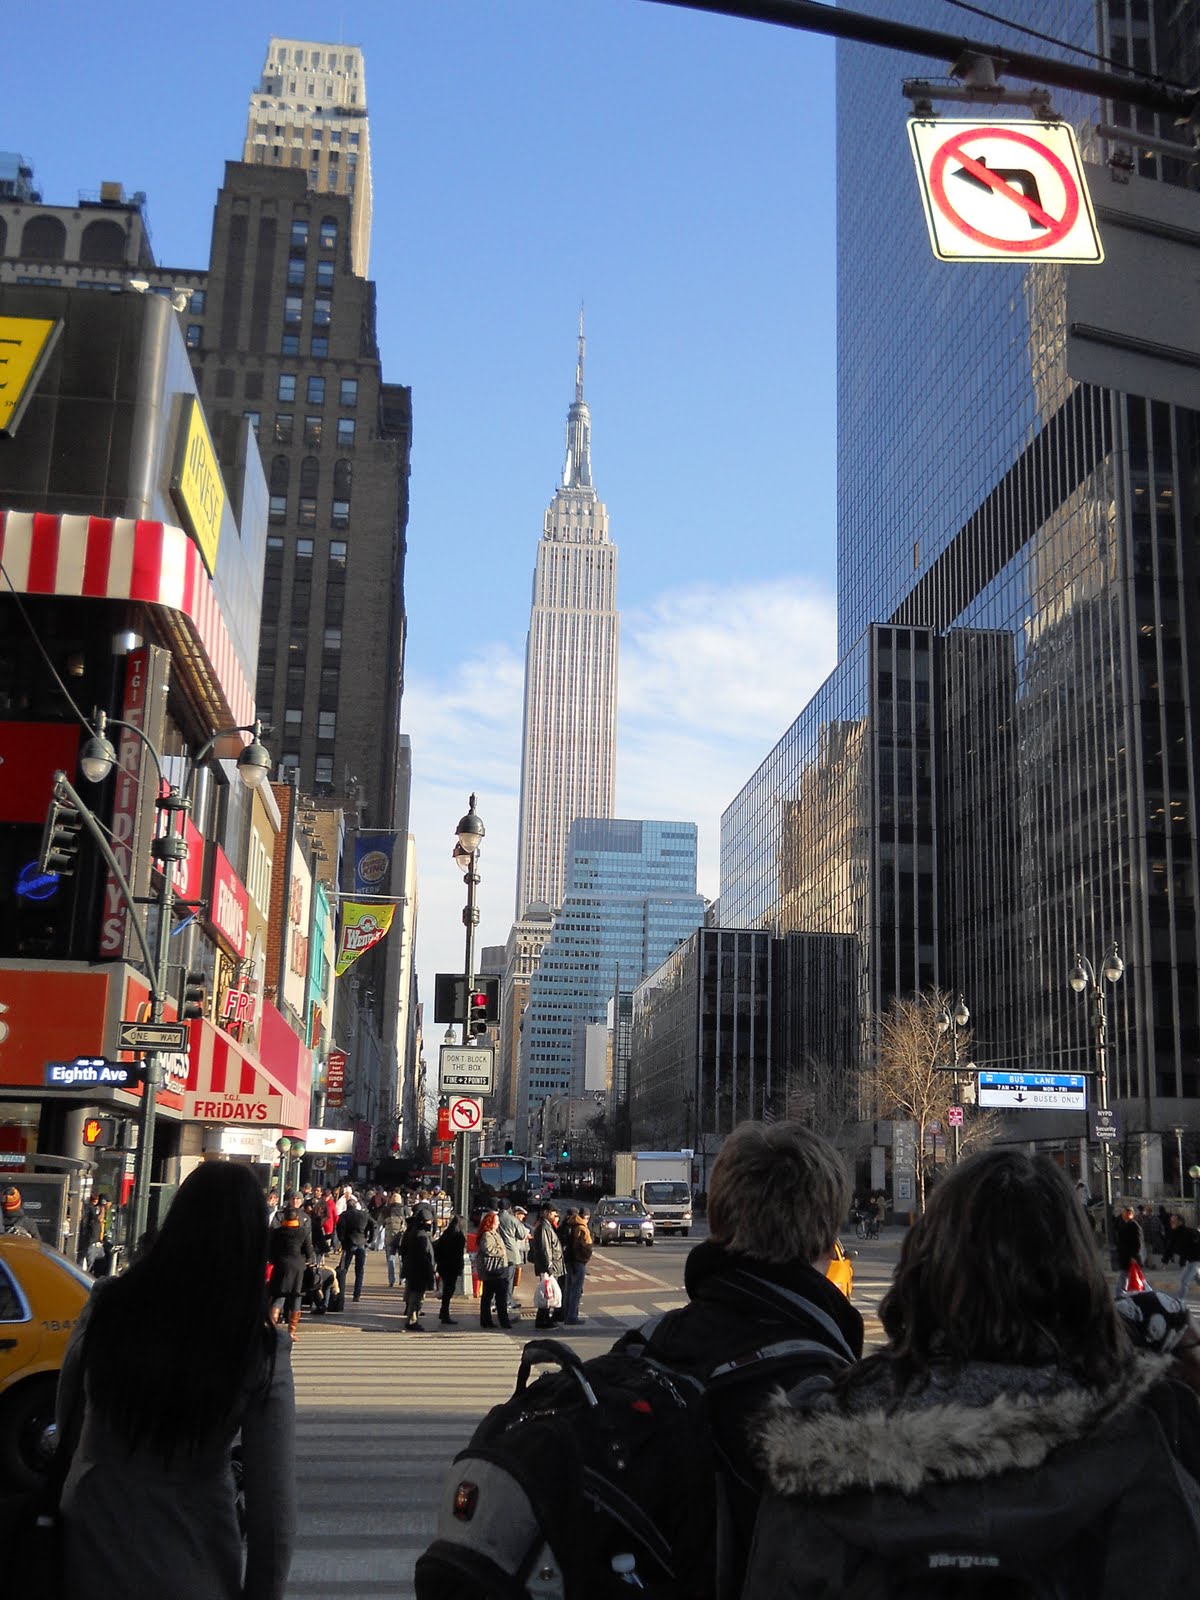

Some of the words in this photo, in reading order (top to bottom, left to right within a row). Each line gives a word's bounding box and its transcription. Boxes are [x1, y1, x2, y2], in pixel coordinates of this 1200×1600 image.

[130, 1031, 149, 1041] ONE
[160, 1033, 180, 1042] WAY
[52, 1066, 98, 1083] Eighth
[100, 1067, 128, 1080] Ave
[446, 1076, 458, 1084] FINE
[468, 1077, 487, 1085] POINTS
[1009, 1075, 1025, 1083] BUS
[1034, 1077, 1055, 1085] LANE
[223, 1094, 241, 1102] T.G.I.
[1033, 1095, 1058, 1103] BUSES
